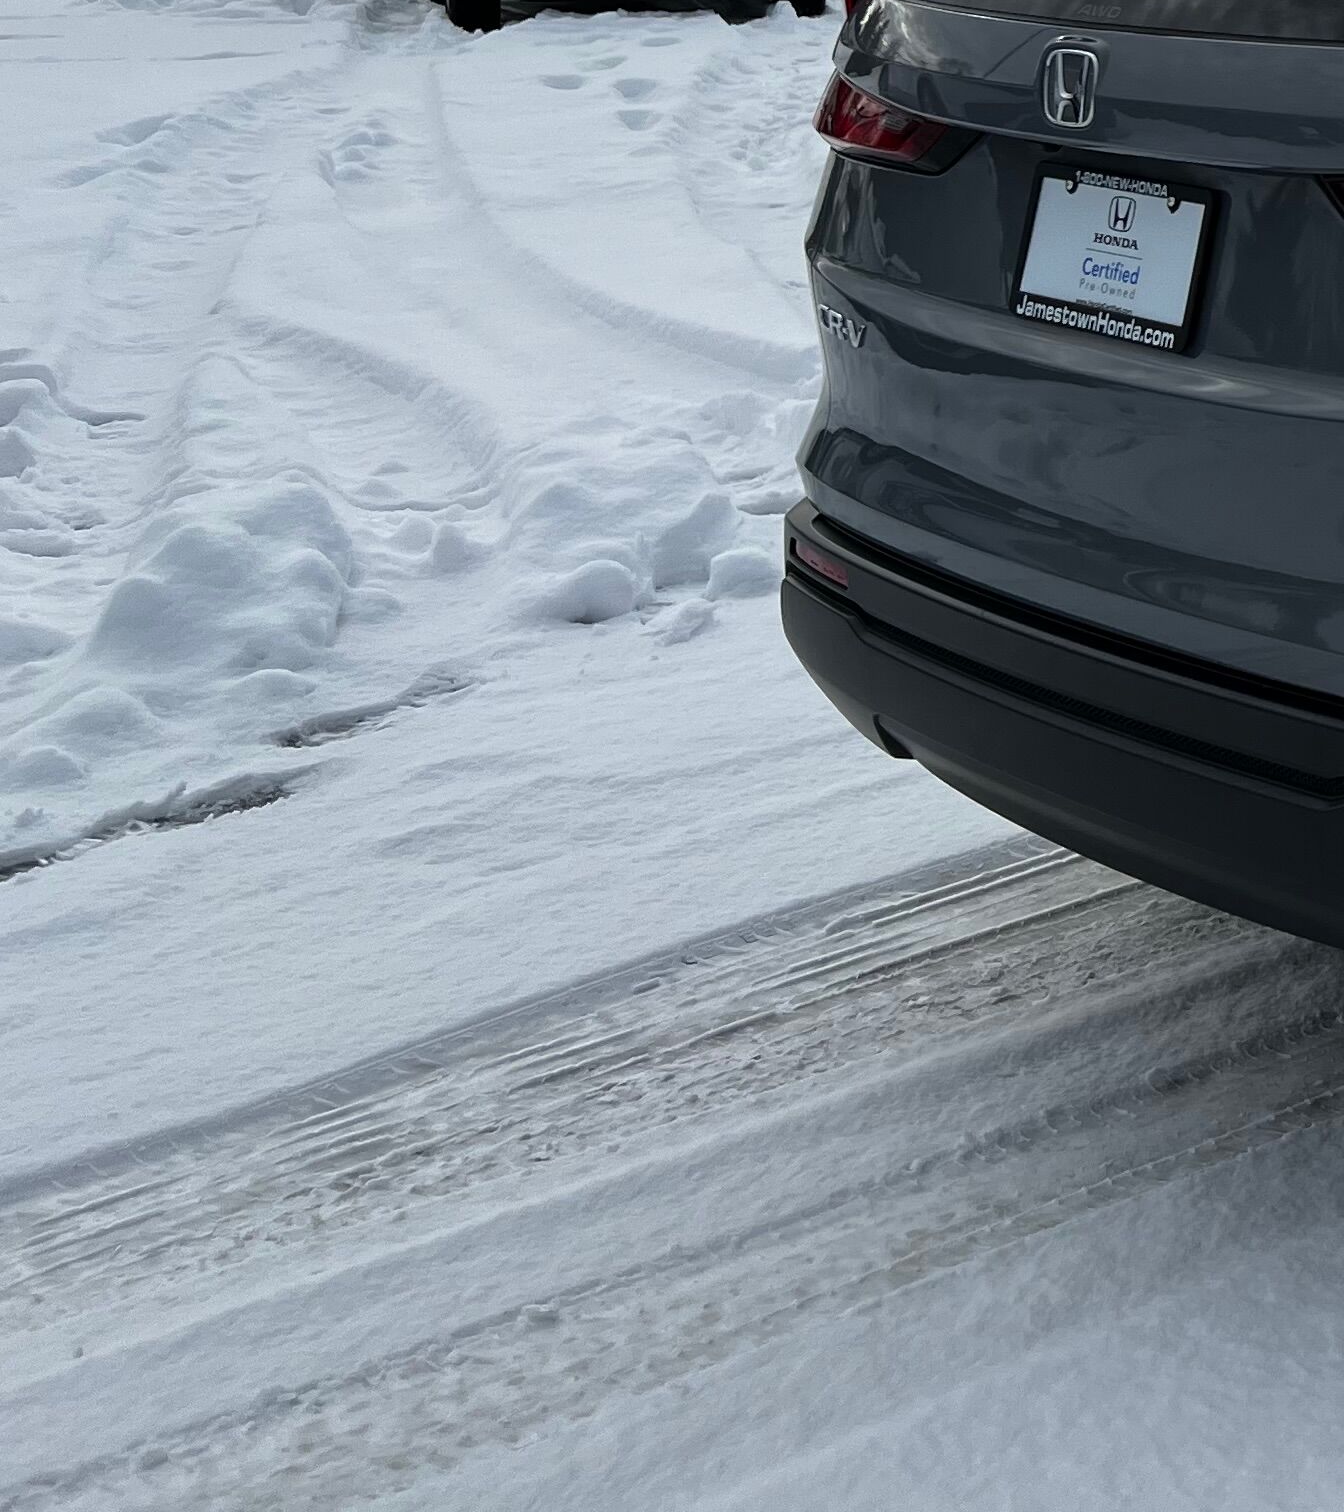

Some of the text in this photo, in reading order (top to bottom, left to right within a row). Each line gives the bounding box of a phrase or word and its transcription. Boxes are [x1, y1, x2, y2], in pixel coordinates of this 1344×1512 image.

[1078, 4, 1121, 18] AWD
[1076, 170, 1168, 197] 1-800-NEW-HONDA
[1093, 232, 1139, 250] HONDA
[1082, 257, 1141, 285] Certified
[818, 303, 866, 348] CR-V
[1016, 294, 1175, 349] JamestownHonda.com
